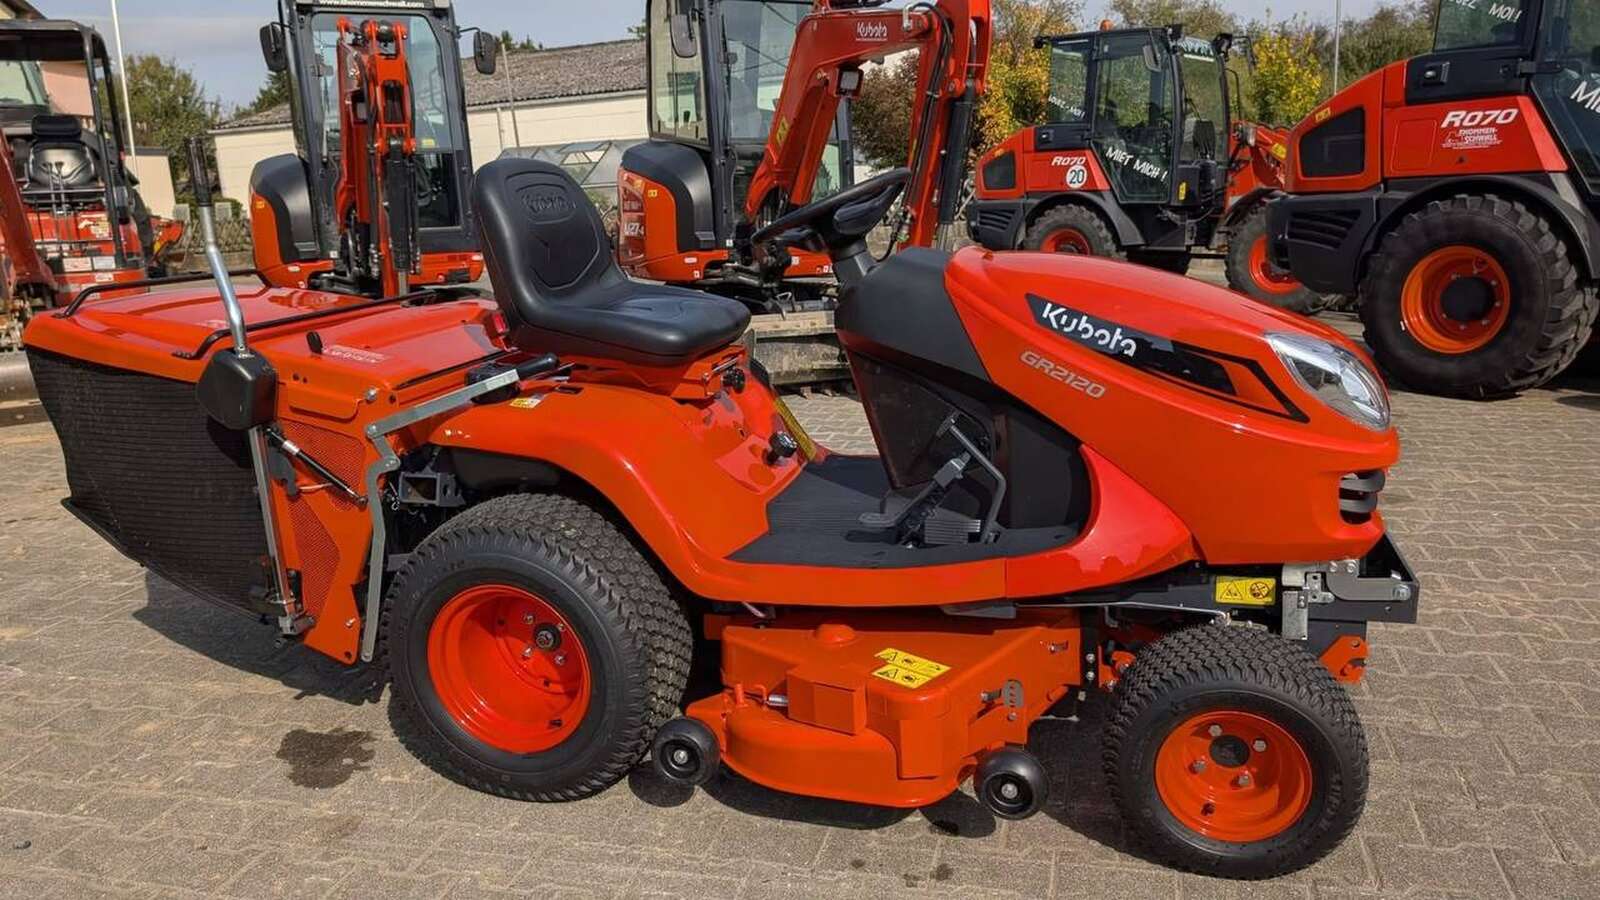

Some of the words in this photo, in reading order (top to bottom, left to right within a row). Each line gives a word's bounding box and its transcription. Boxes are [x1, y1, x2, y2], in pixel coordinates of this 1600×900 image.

[857, 22, 887, 36] Kubota
[1441, 108, 1519, 128] R070
[1069, 168, 1083, 185] 20
[1105, 147, 1134, 166] MIET
[1133, 159, 1161, 180] MICH
[1042, 303, 1136, 357] Kubota
[1020, 351, 1106, 398] GR2120
